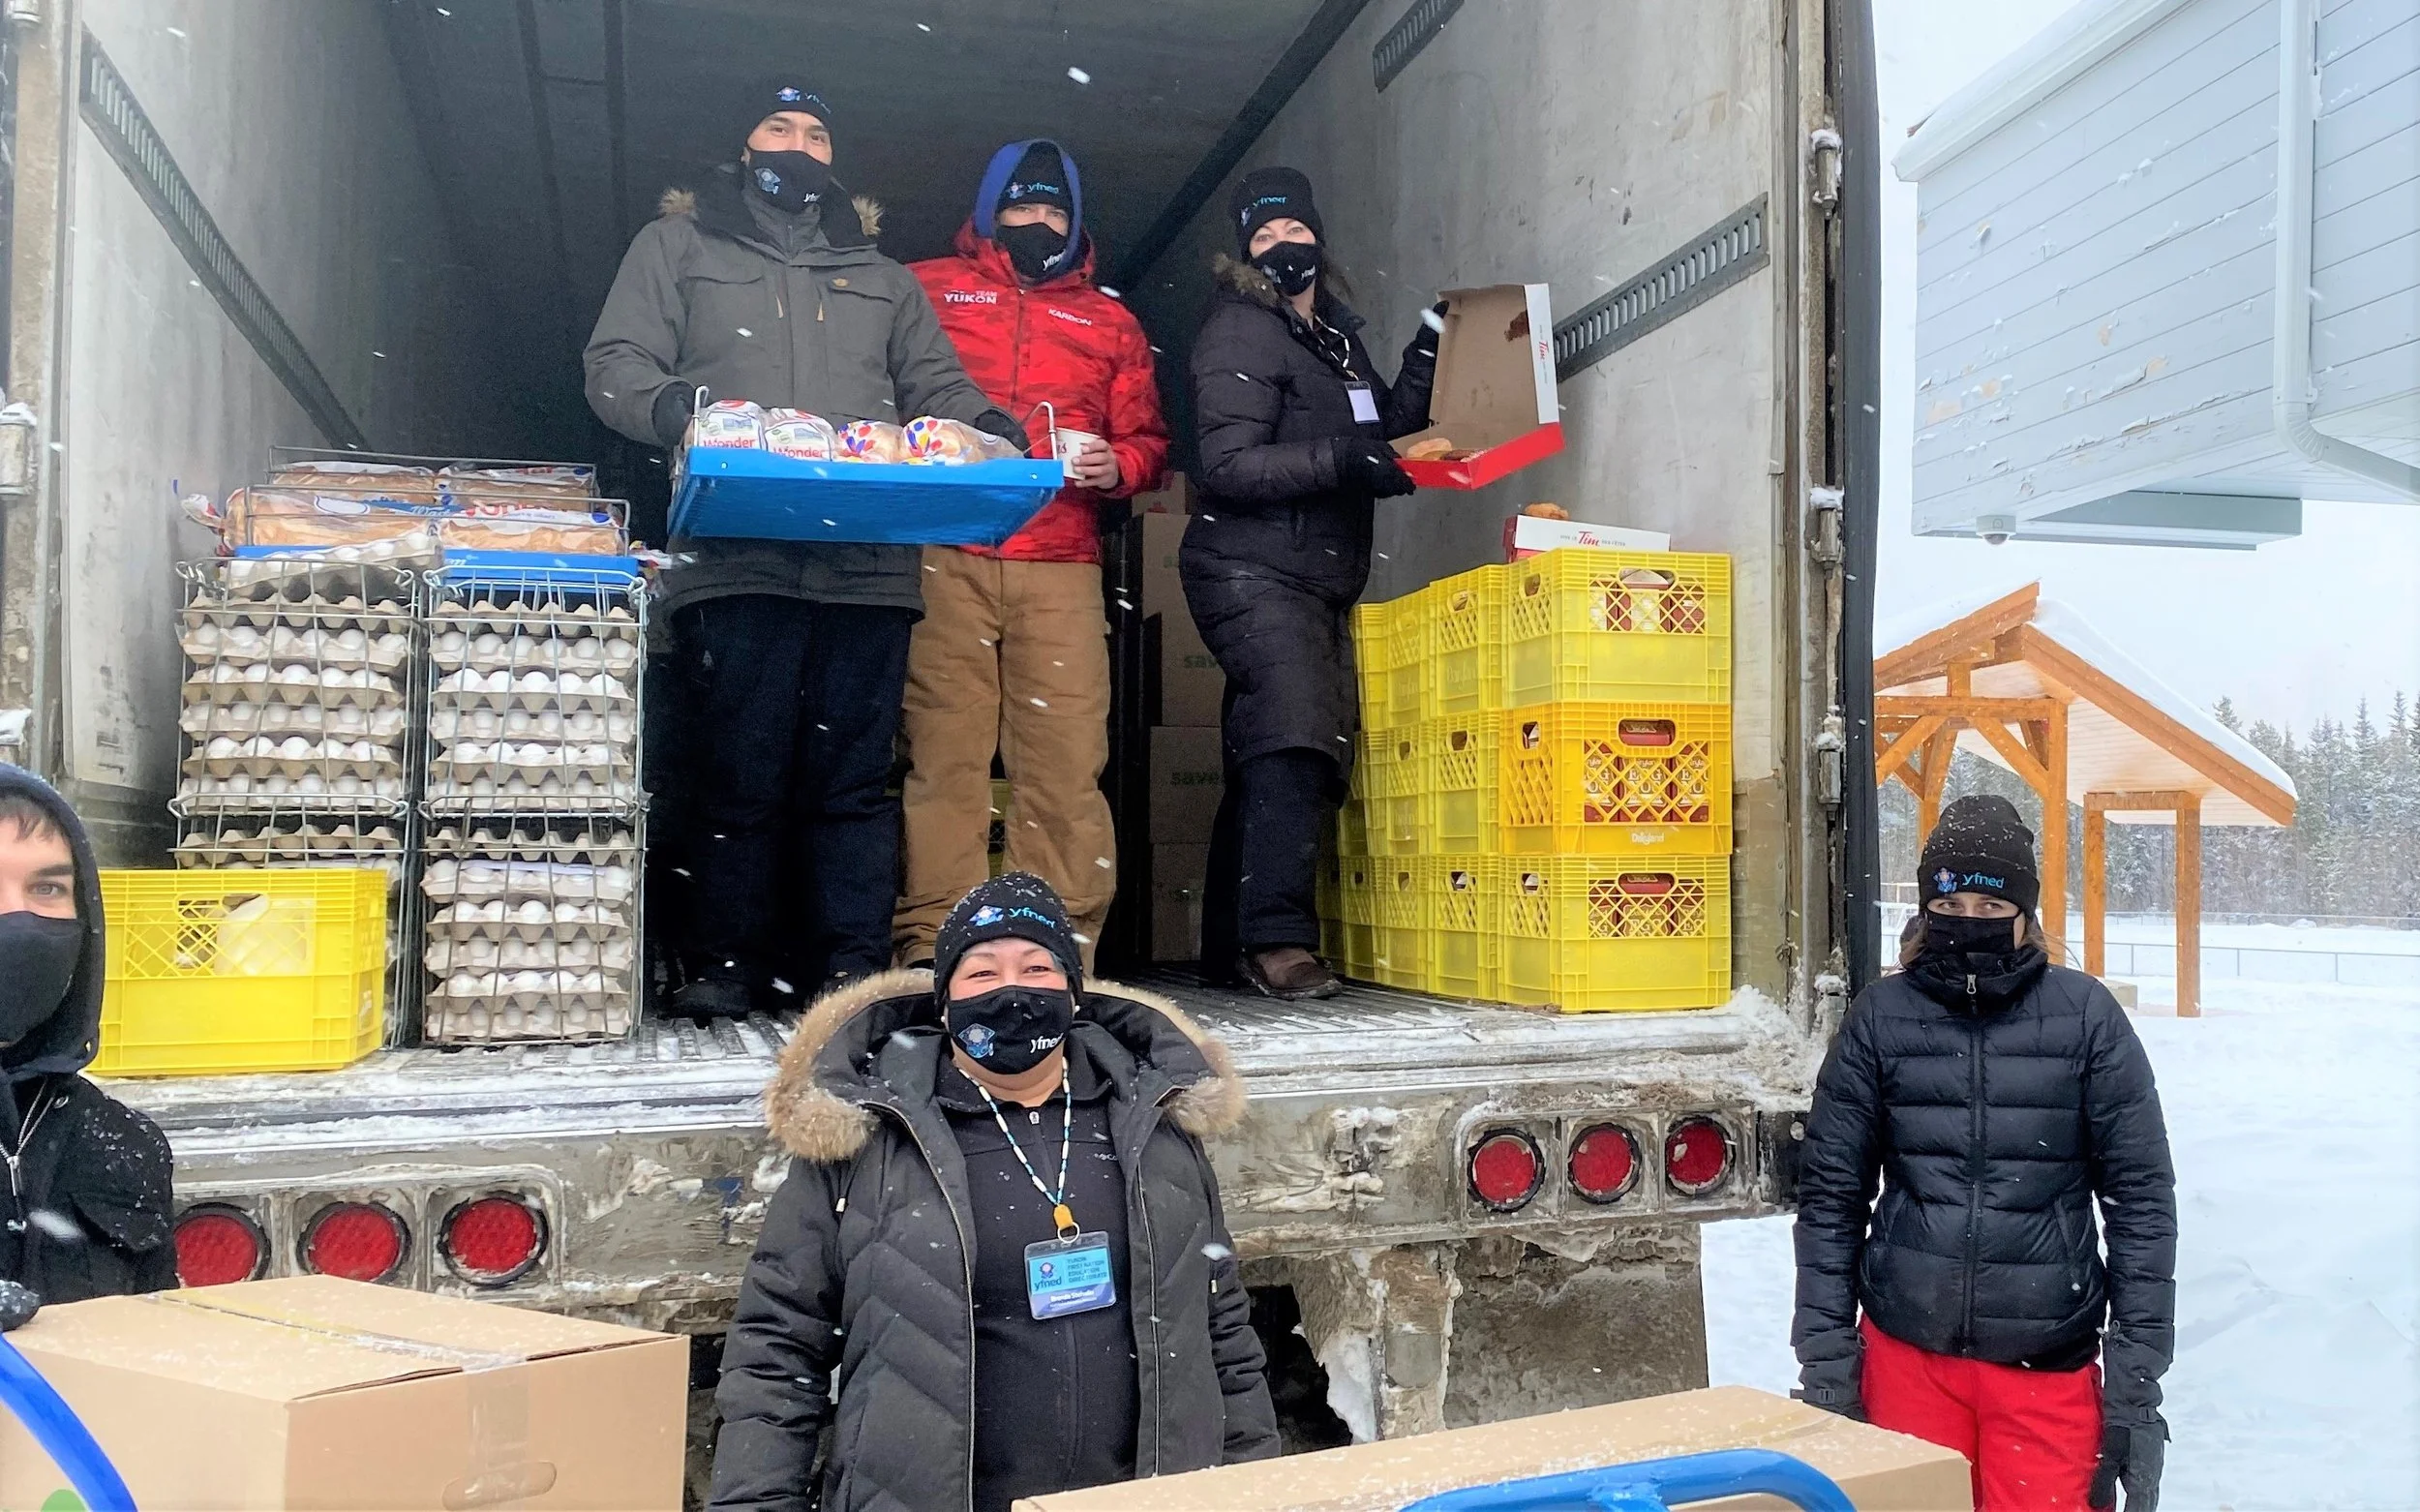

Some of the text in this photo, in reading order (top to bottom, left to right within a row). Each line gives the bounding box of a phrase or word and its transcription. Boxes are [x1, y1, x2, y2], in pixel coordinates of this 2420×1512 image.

[944, 292, 997, 304] YUKON
[704, 437, 756, 448] Wonder
[1578, 530, 1600, 547] Tim
[1183, 654, 1218, 669] sav
[1961, 871, 2005, 890] yfned
[1008, 906, 1056, 929] yfned
[1034, 1275, 1063, 1292] yfned
